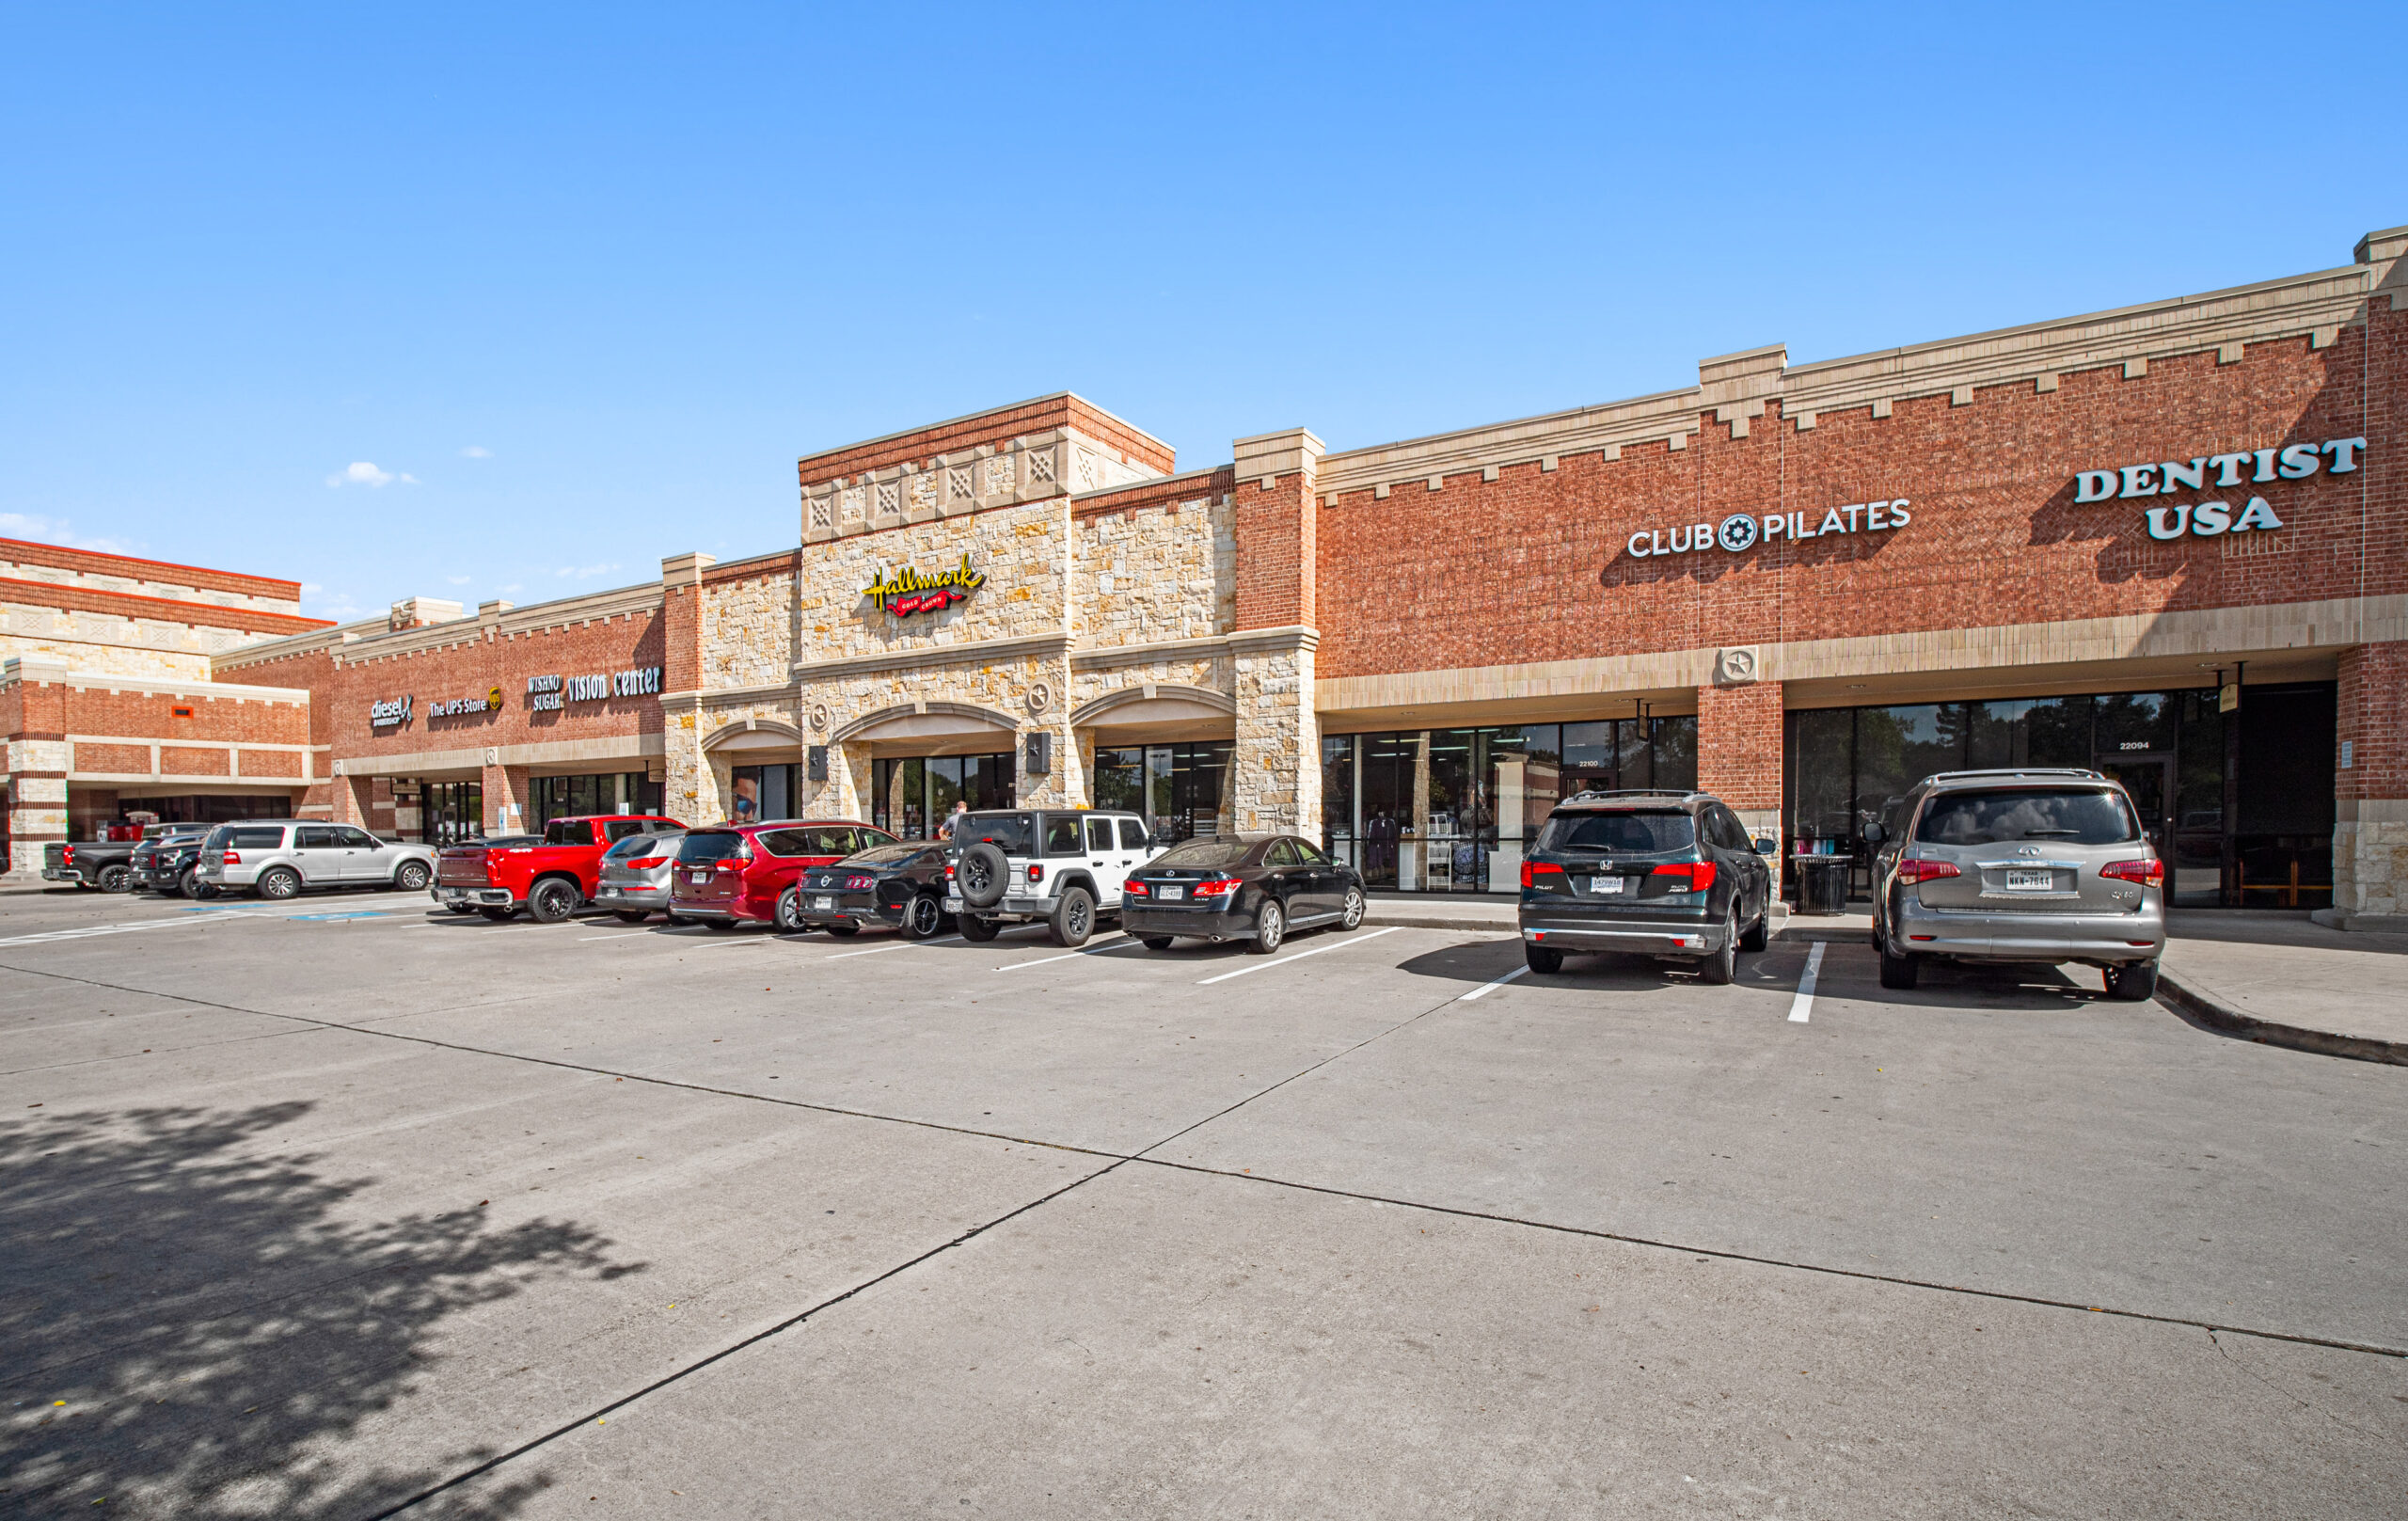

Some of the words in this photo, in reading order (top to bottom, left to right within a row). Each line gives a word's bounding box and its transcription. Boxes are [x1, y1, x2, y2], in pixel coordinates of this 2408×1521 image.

[2073, 436, 2368, 503] DENTIST
[1627, 523, 1715, 558] CLUB
[1763, 499, 1911, 543] PILATES
[2146, 497, 2284, 540] USA
[862, 552, 984, 612] Hallmark
[901, 599, 919, 610] GOLD
[528, 674, 560, 693] WISHNO
[568, 674, 608, 702] vision
[613, 666, 660, 697] center
[372, 696, 402, 719] diesel
[430, 702, 445, 717] The
[446, 698, 463, 716] UPS
[464, 698, 486, 713] Store
[533, 693, 561, 711] SUGAR
[2119, 741, 2149, 750] 22094
